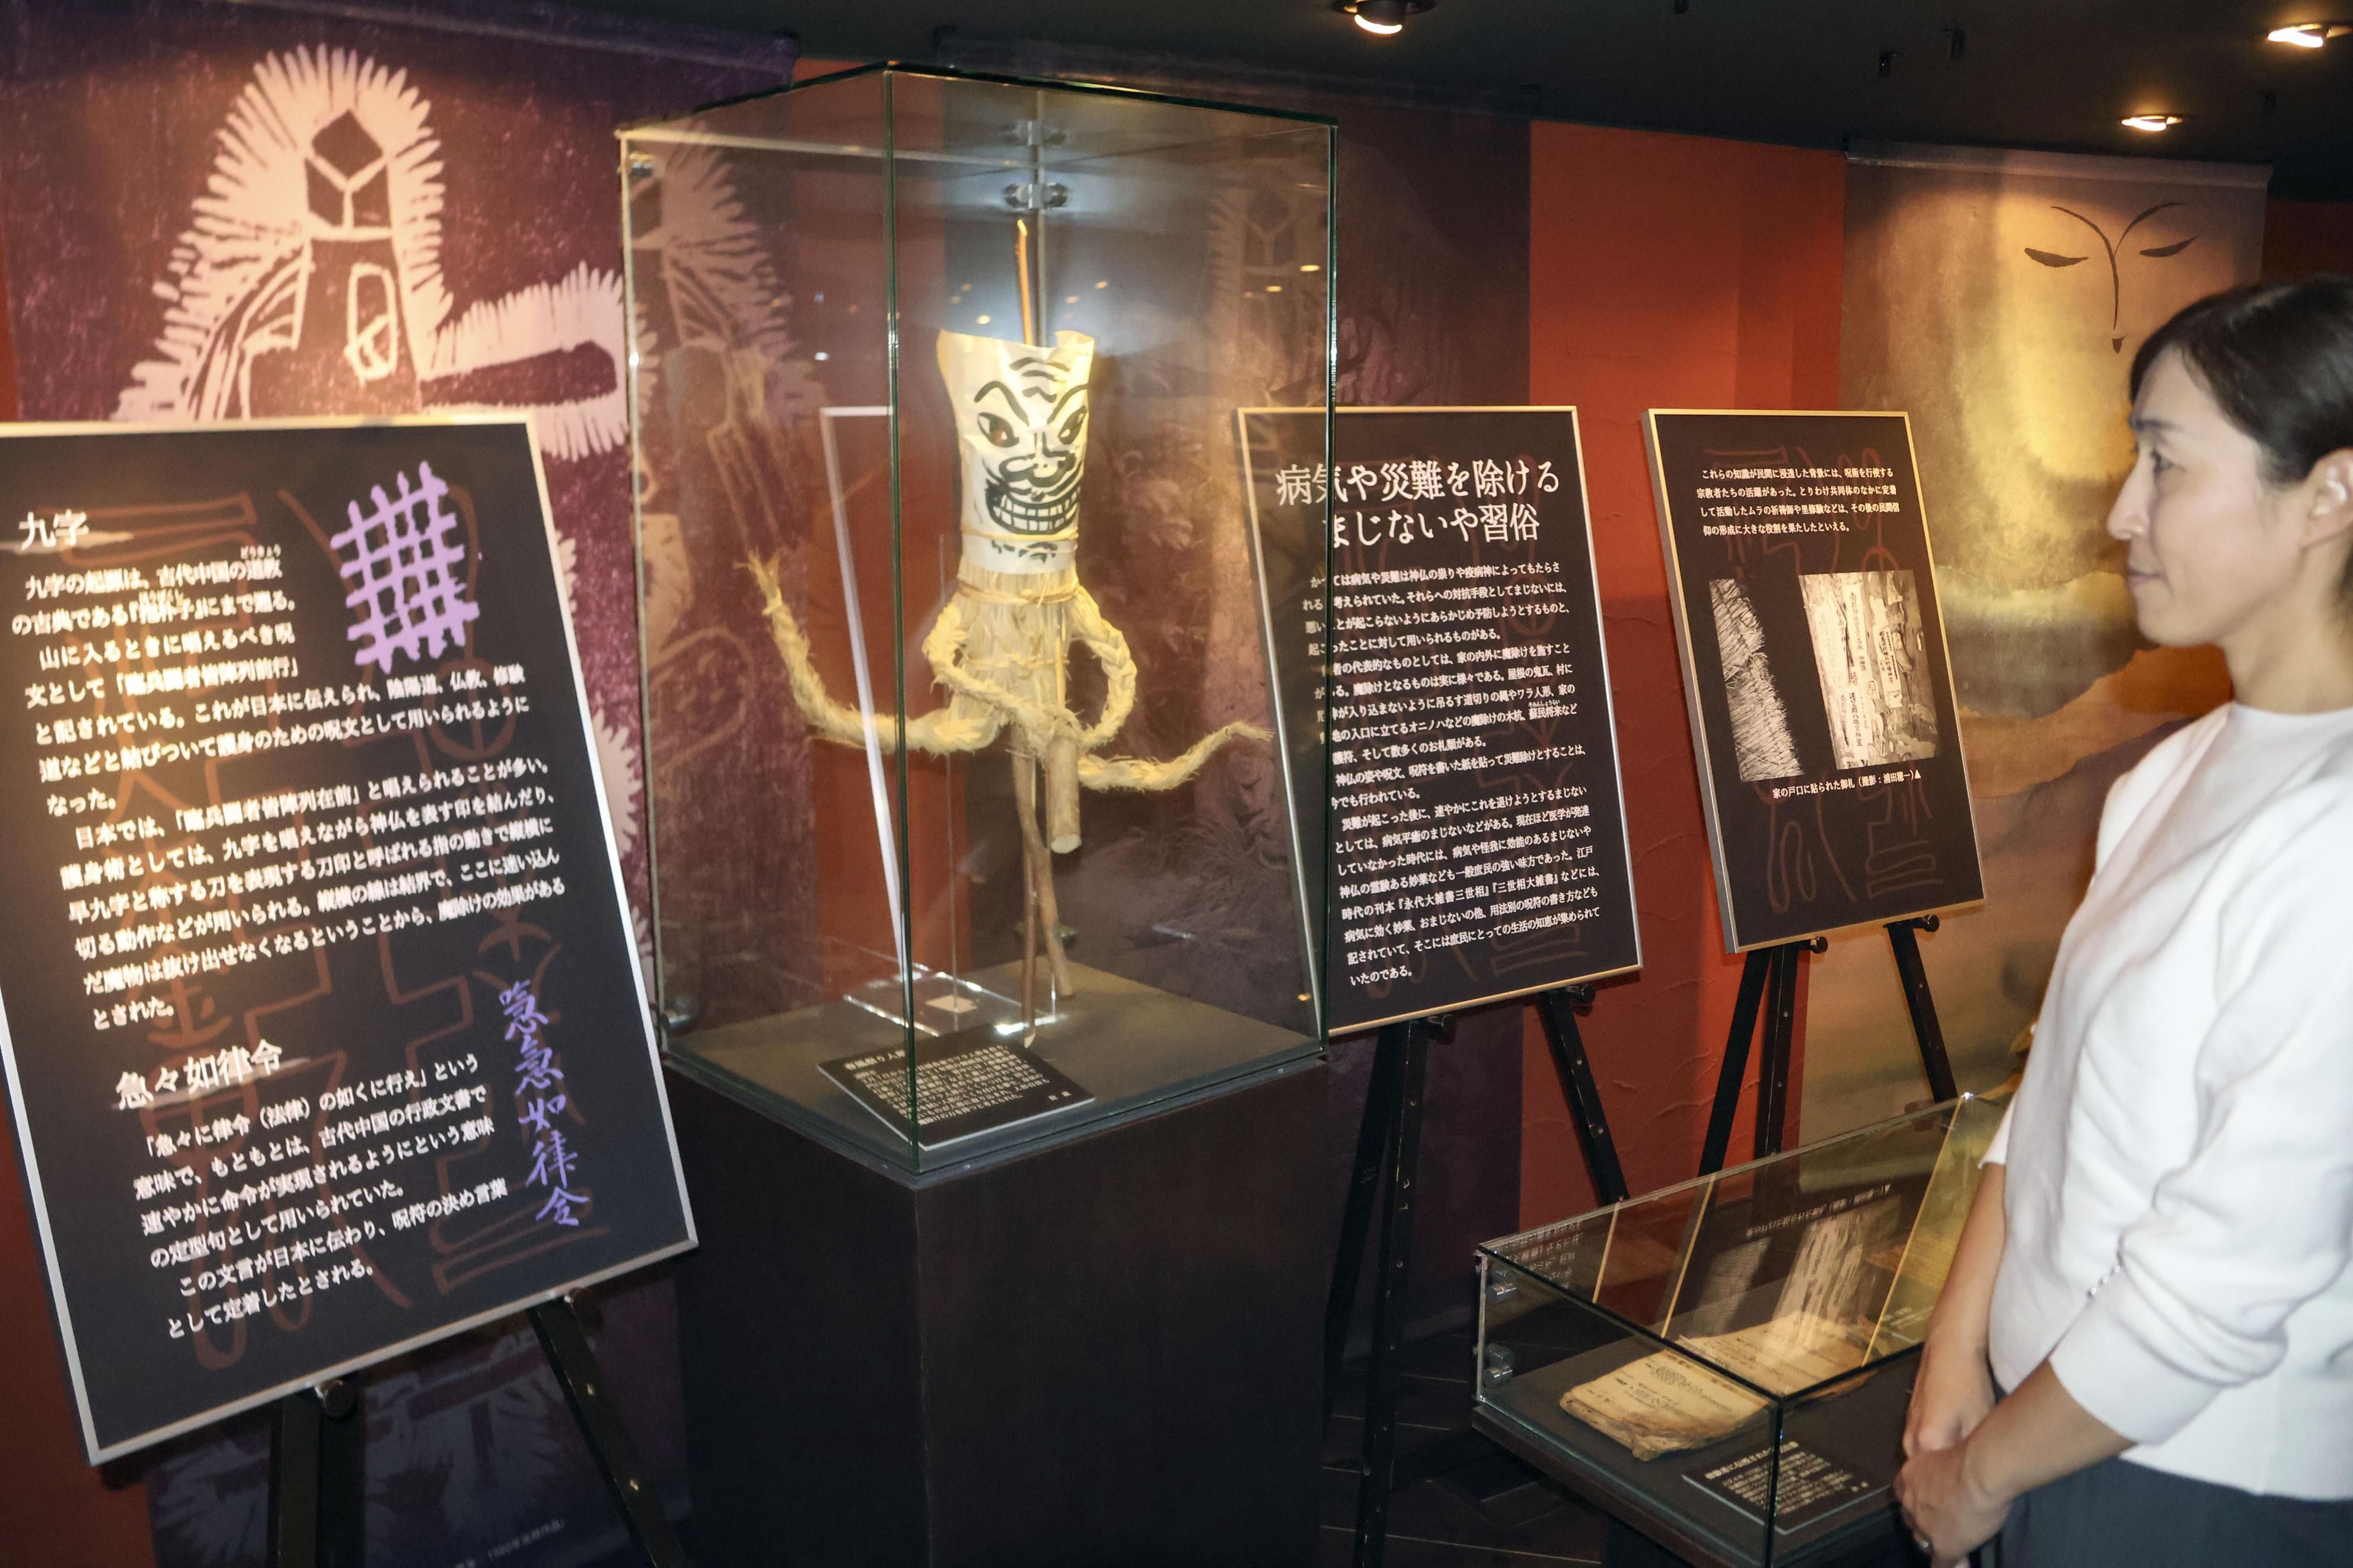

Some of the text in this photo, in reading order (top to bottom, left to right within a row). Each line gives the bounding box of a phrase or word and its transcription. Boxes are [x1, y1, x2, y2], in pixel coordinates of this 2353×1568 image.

[1276, 459, 1558, 506] 病気や災難を除ける
[19, 509, 90, 550] 九字
[1323, 503, 1539, 548] まじないや習俗
[1303, 582, 1566, 610] れる考えられていた。それらへの対抗手段としてまじないには、
[1306, 603, 1569, 633] 悪いとが起こらないようにあらかじめ予防しようとするものと、
[40, 623, 295, 670] 山に入るときに唱えるべき呪
[1322, 643, 1570, 675] 者の代表的なものとしては、家の内外に魔除けを施すこと
[1315, 663, 1573, 698] がる。魔除けとなるものは実に様々である。屋根の鬼瓦、村に
[1320, 701, 1577, 744] 地の入口に立てるオニノハなどの魔除けの木杭、蘇民将来など
[47, 788, 116, 816] なった。
[1332, 788, 1420, 809] 今でも行われている。
[1350, 966, 1412, 985] いたのである。
[94, 997, 174, 1030] とされた。
[116, 1040, 282, 1110] 急々如律令
[134, 1085, 486, 1200] 意味で、もともとは、古代中国の行政文書で
[141, 1116, 495, 1236] 速やかに命令が実現されるようにという意味
[151, 1180, 403, 1267] の定型句として用いられていた。
[169, 1259, 373, 1337] として定着したとされる。
